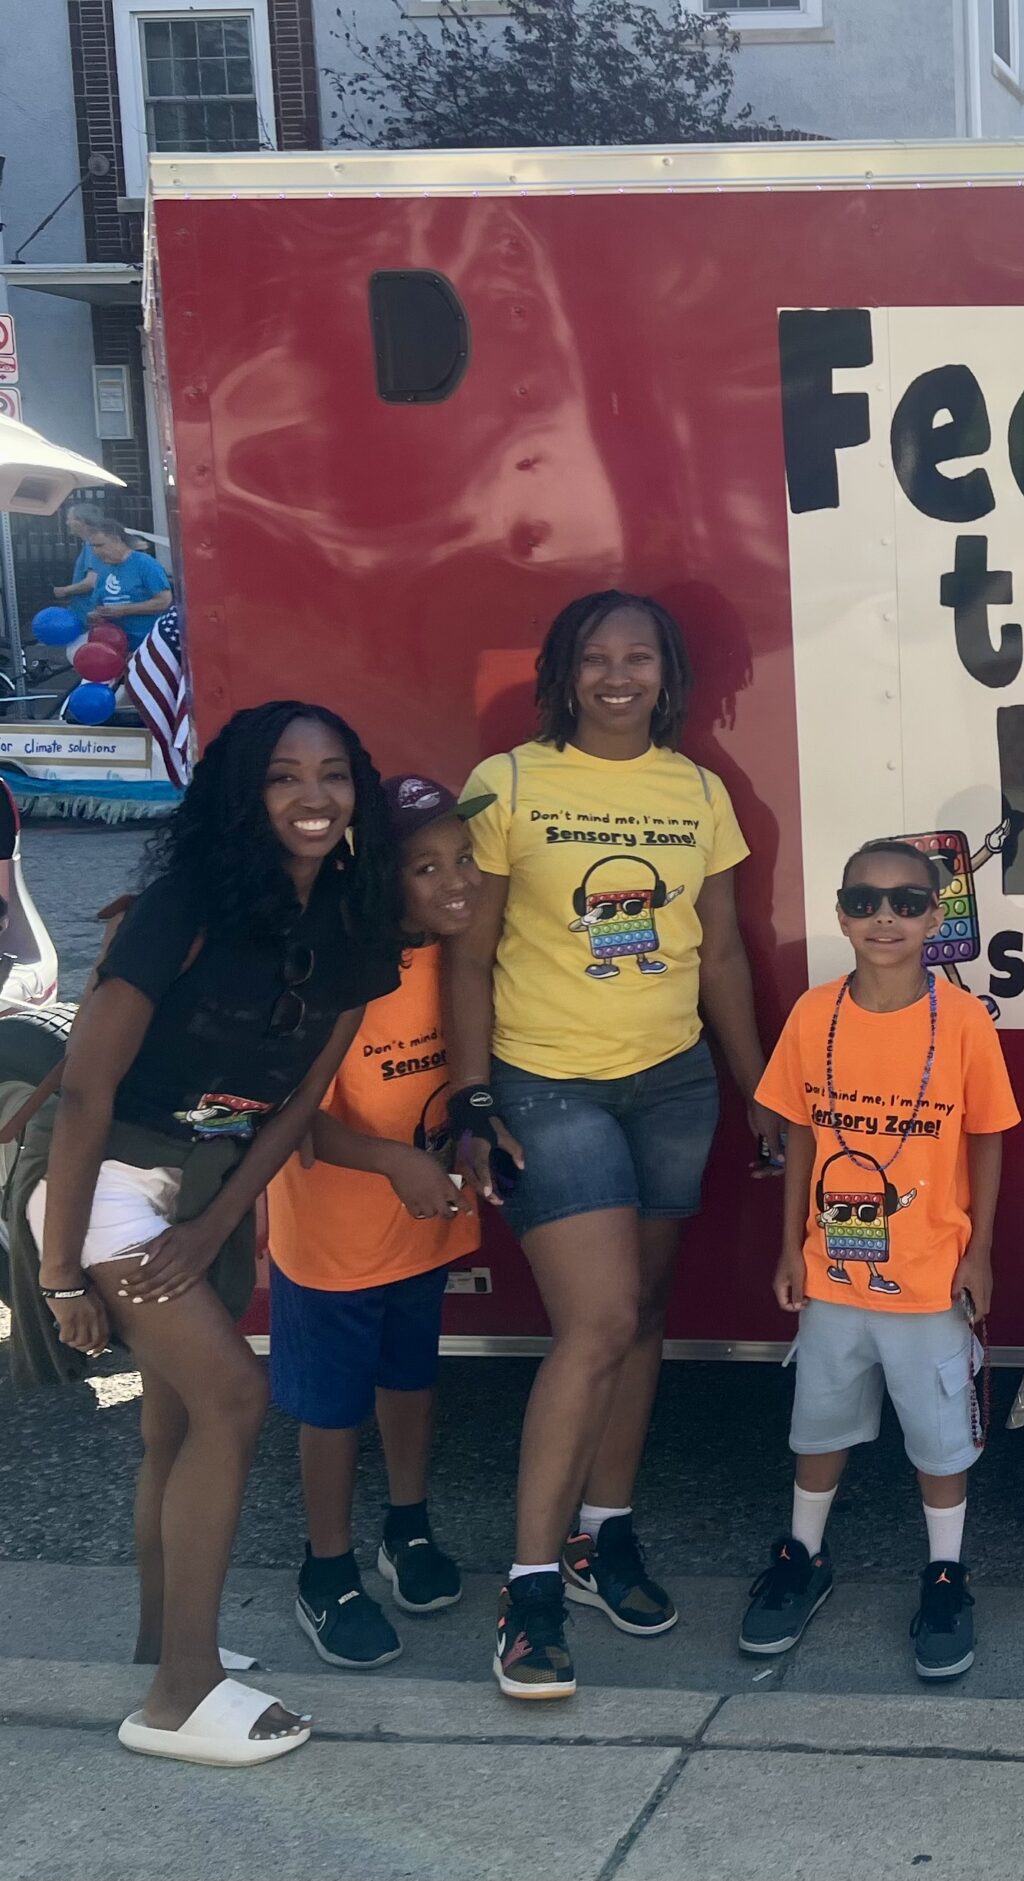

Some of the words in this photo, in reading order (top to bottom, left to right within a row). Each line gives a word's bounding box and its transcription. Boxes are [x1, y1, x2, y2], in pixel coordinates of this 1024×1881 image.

[0, 737, 13, 751] or
[24, 739, 63, 754] climate
[67, 739, 117, 754] solutions
[530, 810, 572, 822] Don't
[576, 813, 610, 824] mind
[615, 816, 640, 825] me,
[643, 815, 664, 825] I'm
[668, 817, 679, 825] in
[682, 819, 699, 830] my
[546, 826, 637, 847] Sensory
[643, 830, 697, 845] Zone!
[363, 1039, 405, 1057] Don't
[410, 1027, 438, 1047] mind
[381, 1048, 448, 1080] Sensor
[862, 1095, 886, 1106] me,
[890, 1094, 912, 1106] I'm
[934, 1102, 955, 1116] my
[884, 1115, 942, 1136] Zone!
